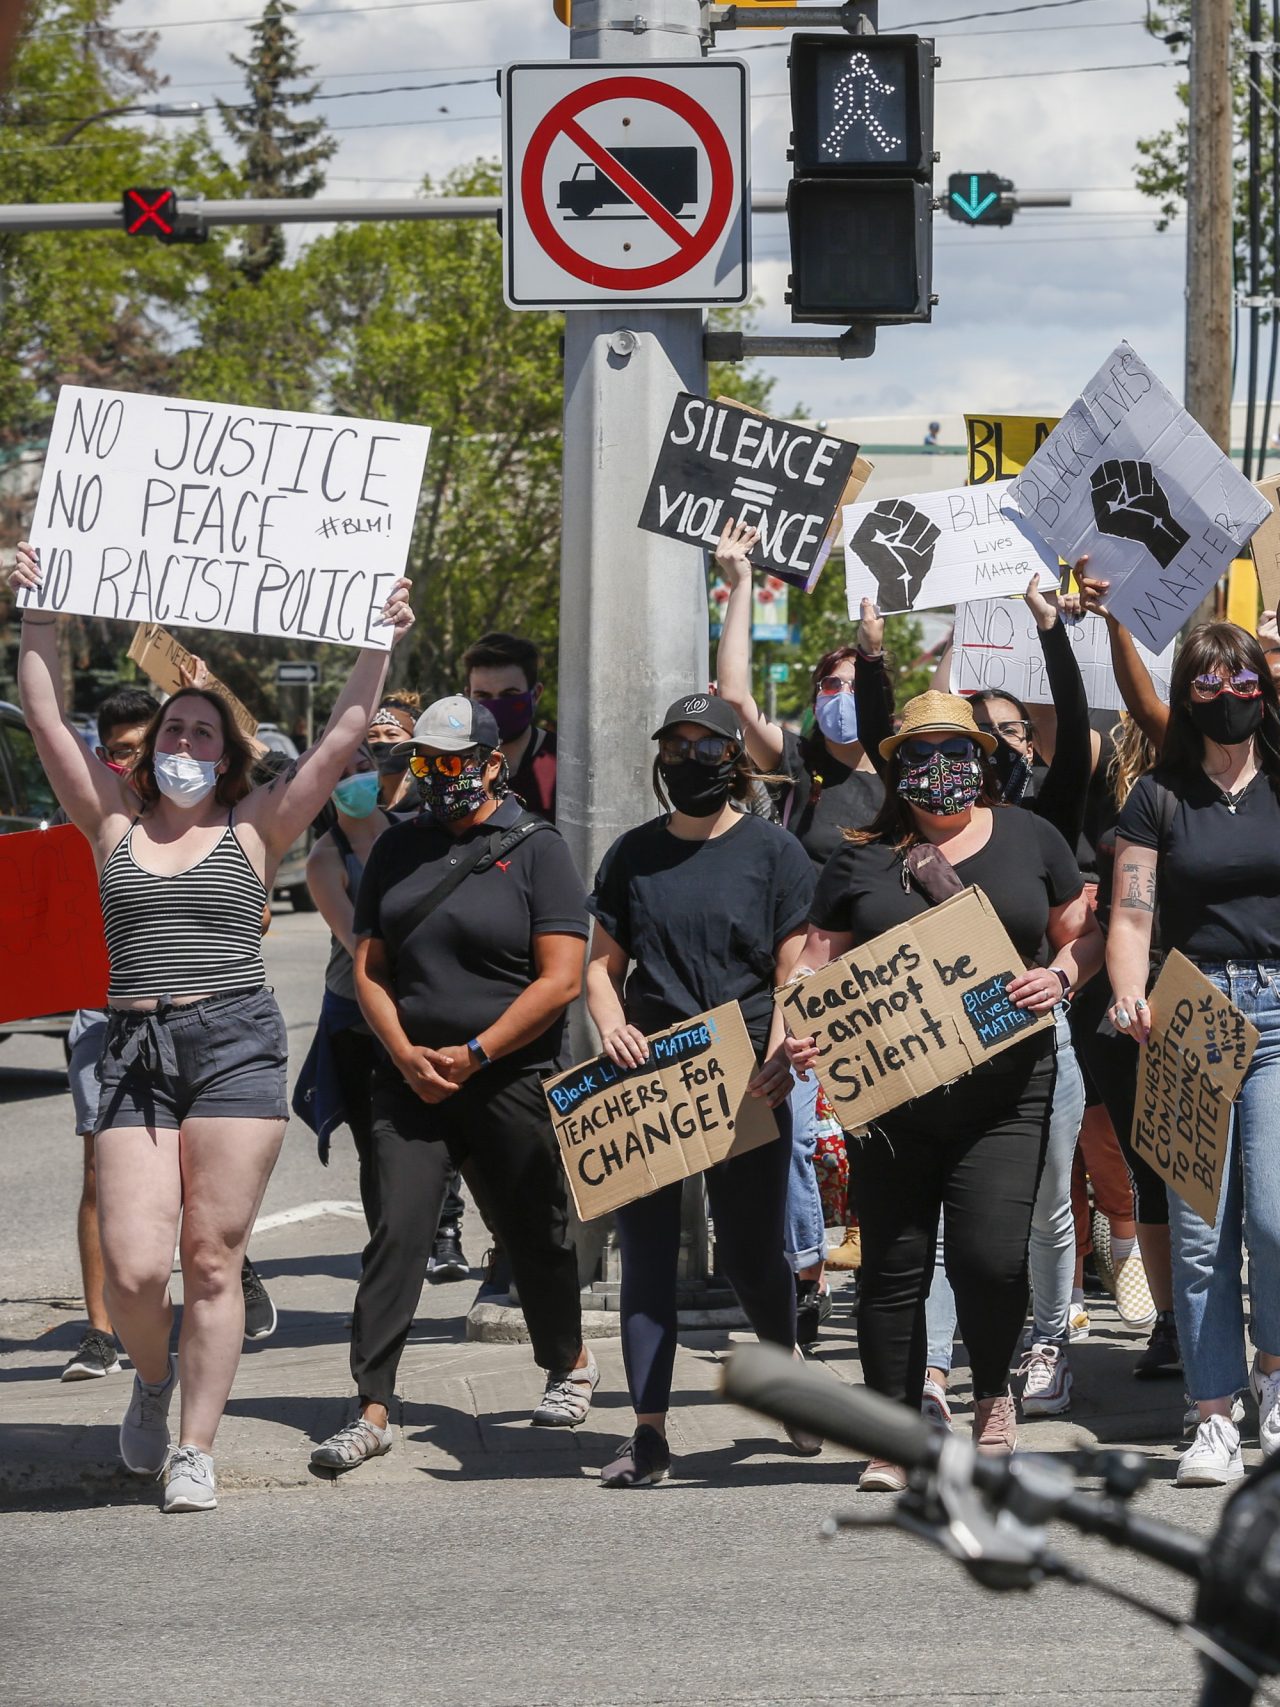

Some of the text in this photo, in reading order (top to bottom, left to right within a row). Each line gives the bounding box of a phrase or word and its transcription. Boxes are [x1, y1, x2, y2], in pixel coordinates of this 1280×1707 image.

[65, 398, 401, 507] NO JUSTICE
[670, 400, 841, 486] SILENCE
[1016, 432, 1093, 528] BLACK
[1078, 353, 1152, 445] LIVES
[48, 470, 392, 563] NO PEACE #BLM!
[659, 485, 824, 571] VIOLENCE
[973, 536, 1013, 554] Lives
[23, 547, 396, 646] NO RACIST POLICE
[962, 601, 1014, 648] NO
[959, 648, 1006, 690] NO
[784, 943, 920, 1021] Teachers
[813, 954, 977, 1057] cannot be
[551, 1074, 598, 1111] Black
[828, 1008, 947, 1102] Silent
[1135, 1040, 1162, 1152] TEACHERS
[1155, 998, 1194, 1169] COMMITTED
[556, 1079, 668, 1148] TEACHERS
[578, 1082, 735, 1186] CHANGE!
[1173, 1048, 1200, 1184] TO DOING
[1193, 1072, 1223, 1196] BETTER
